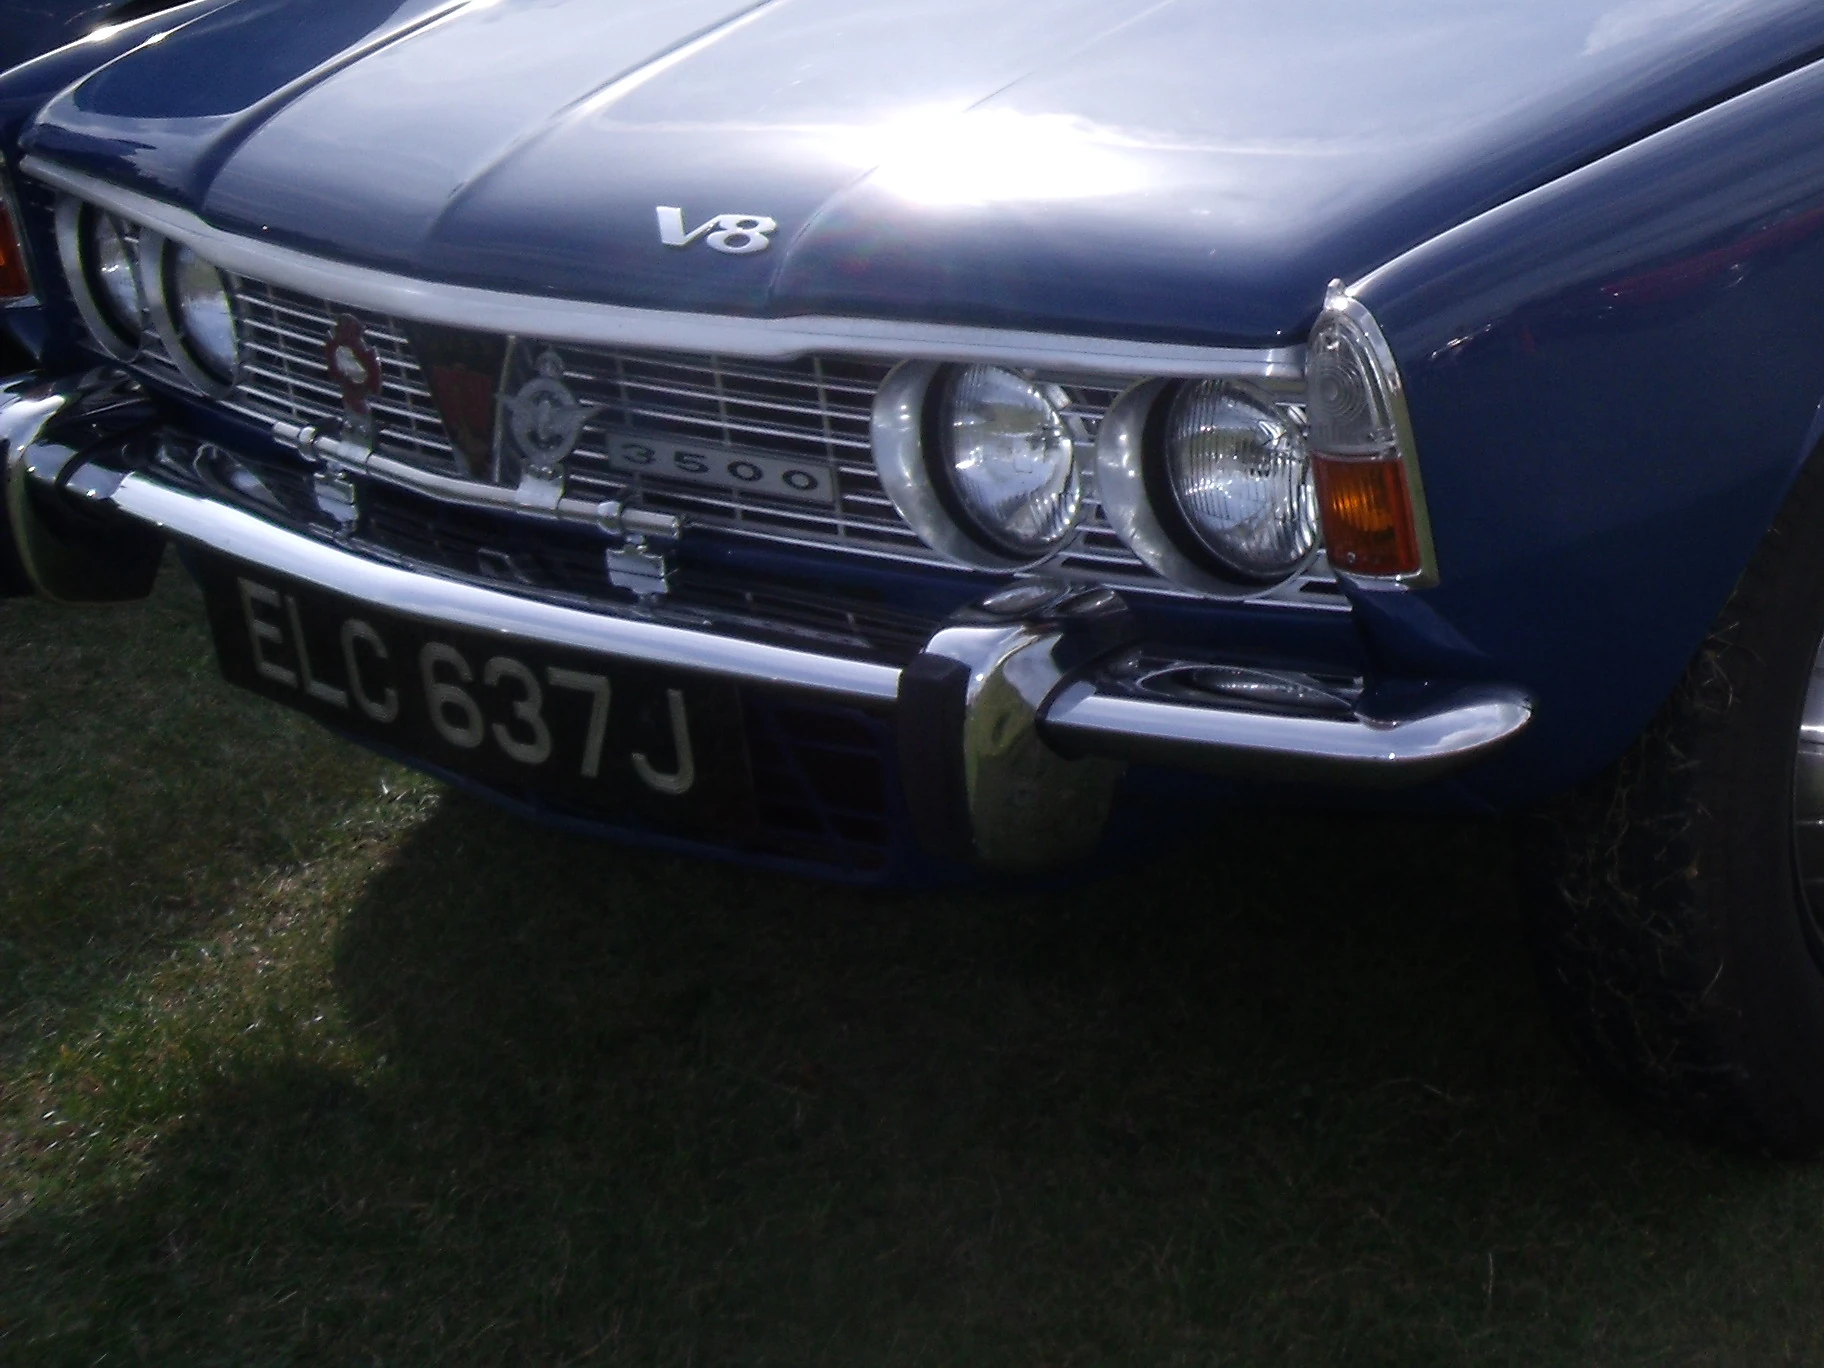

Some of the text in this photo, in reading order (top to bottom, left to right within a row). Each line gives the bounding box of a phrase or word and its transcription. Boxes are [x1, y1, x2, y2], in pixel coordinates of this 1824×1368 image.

[656, 205, 777, 253] V8
[620, 443, 818, 491] 3500
[238, 576, 399, 723] ELC
